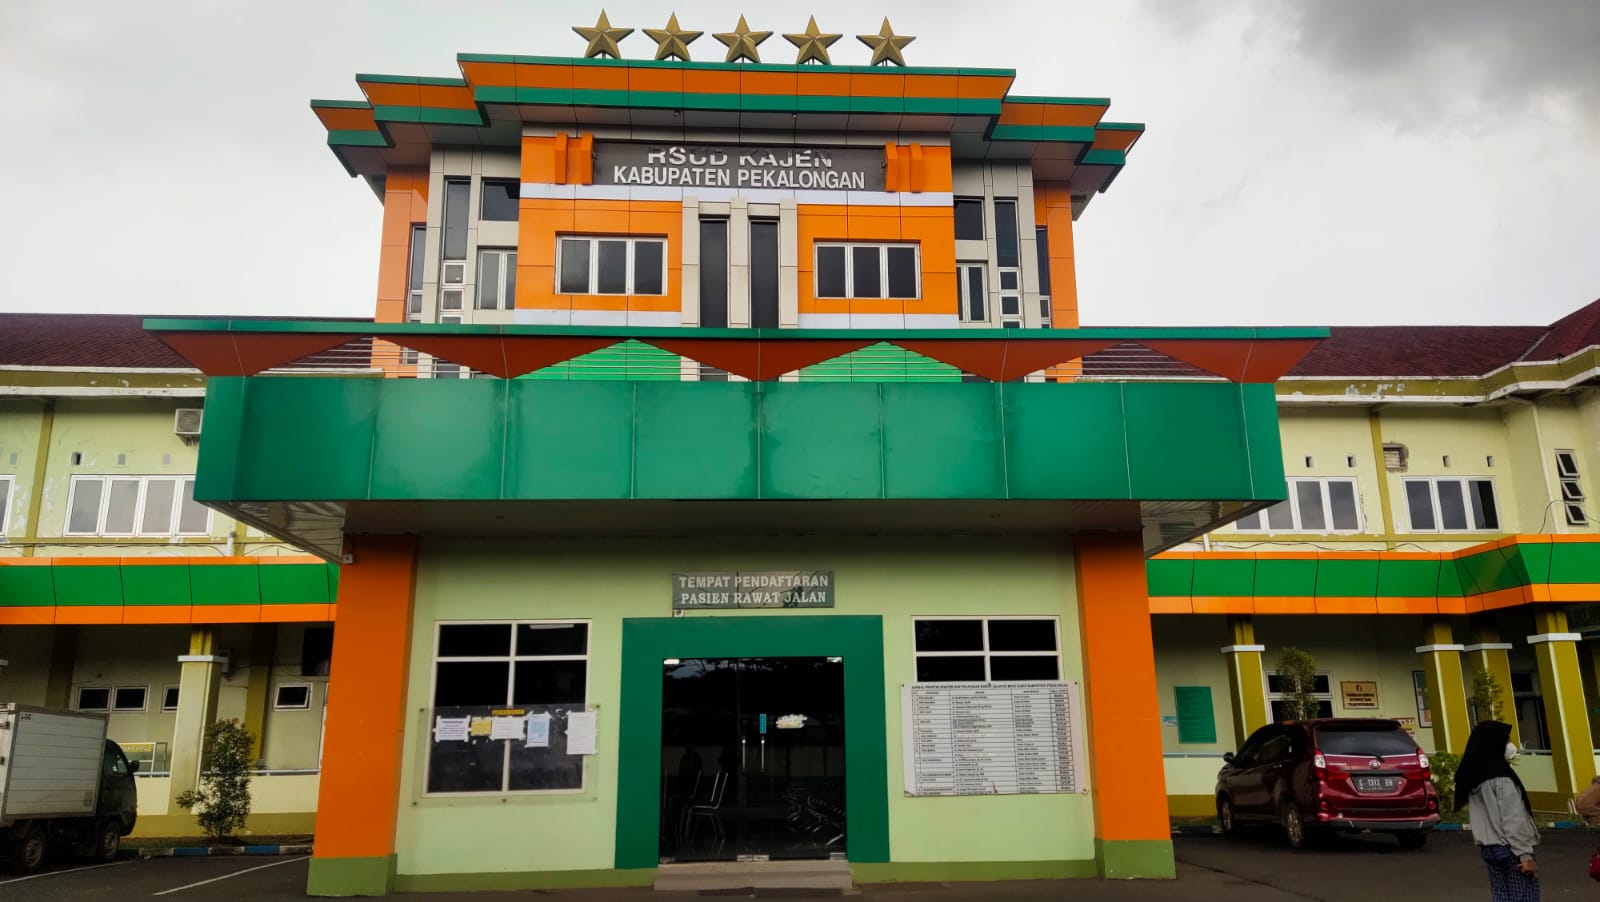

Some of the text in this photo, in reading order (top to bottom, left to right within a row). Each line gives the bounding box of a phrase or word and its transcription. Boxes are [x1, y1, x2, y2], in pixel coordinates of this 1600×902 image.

[647, 146, 833, 168] RSUD KAJEN
[613, 165, 865, 189] KABUPATEN PEKALONGAN
[678, 575, 828, 588] TEMPAT PENDAFTARAN
[681, 591, 826, 605] PASIEN RAWAT JALAN
